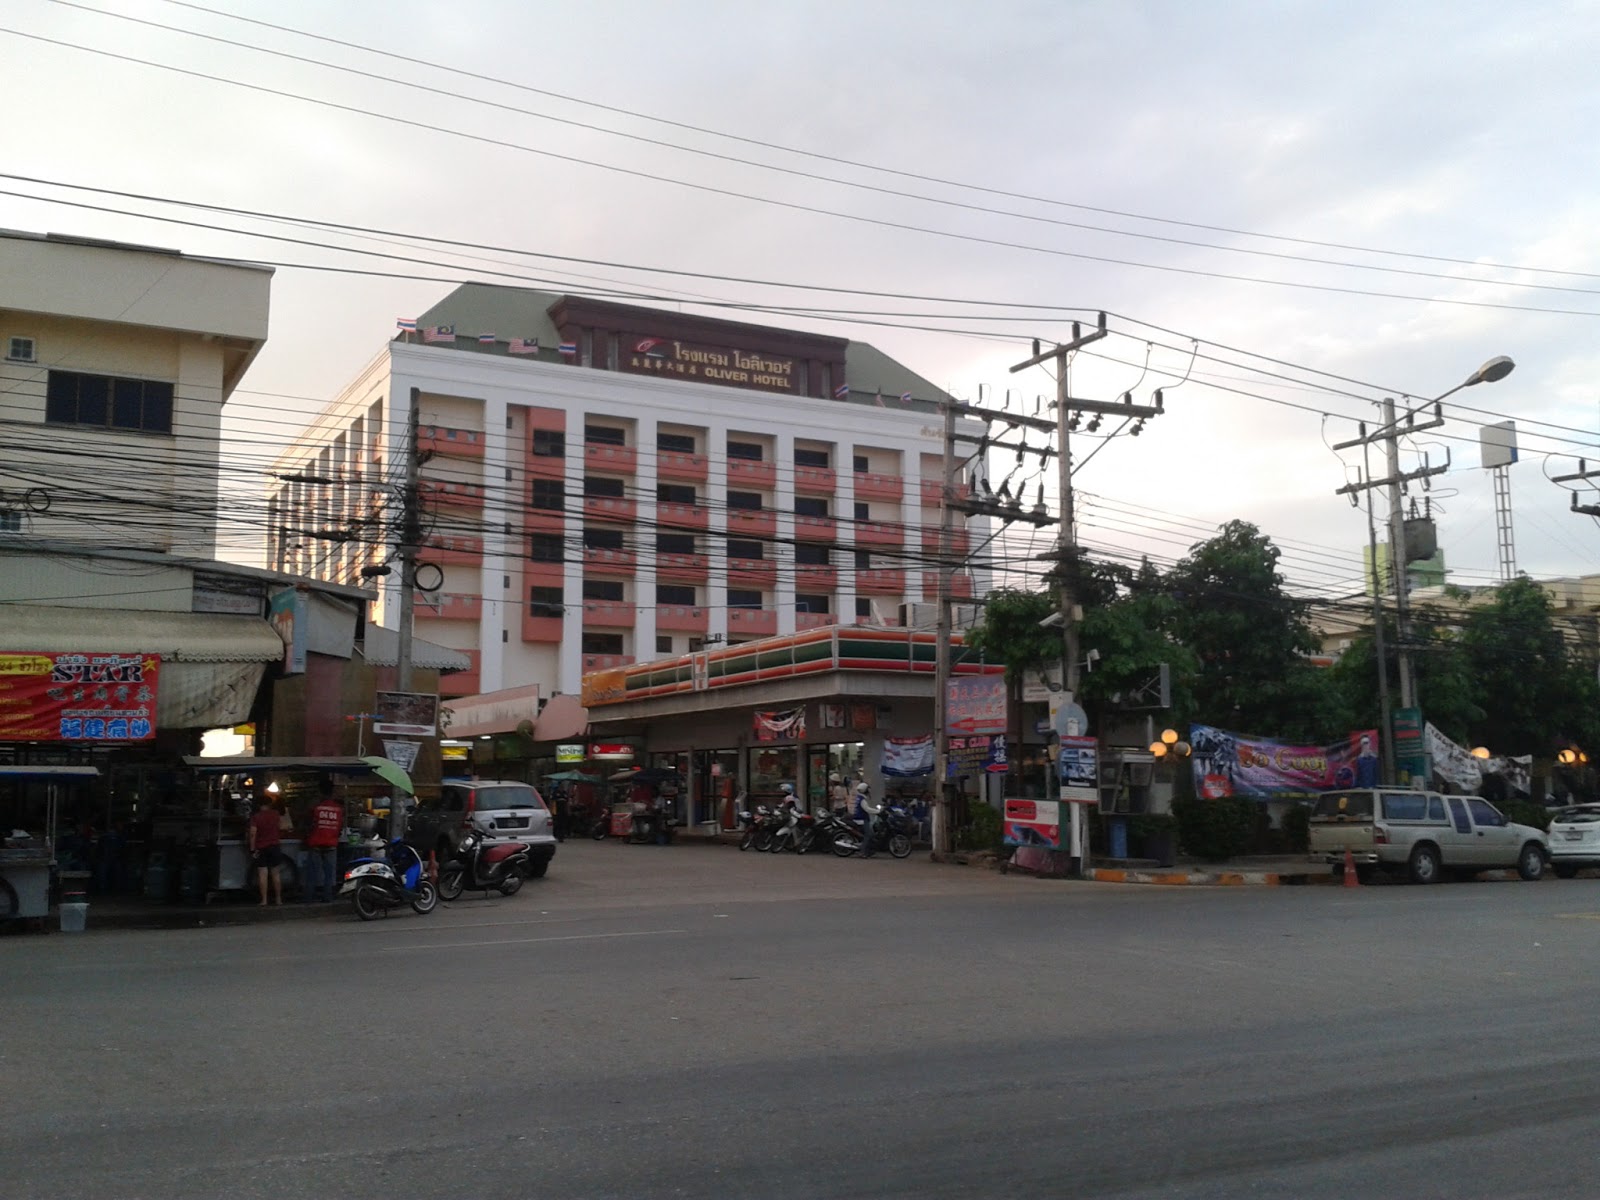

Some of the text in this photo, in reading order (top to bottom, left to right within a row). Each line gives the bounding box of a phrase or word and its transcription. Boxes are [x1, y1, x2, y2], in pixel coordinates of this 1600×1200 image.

[674, 342, 728, 366] โรงแรม
[704, 367, 791, 387] OLIVER HOTEL
[52, 664, 144, 683] STAR
